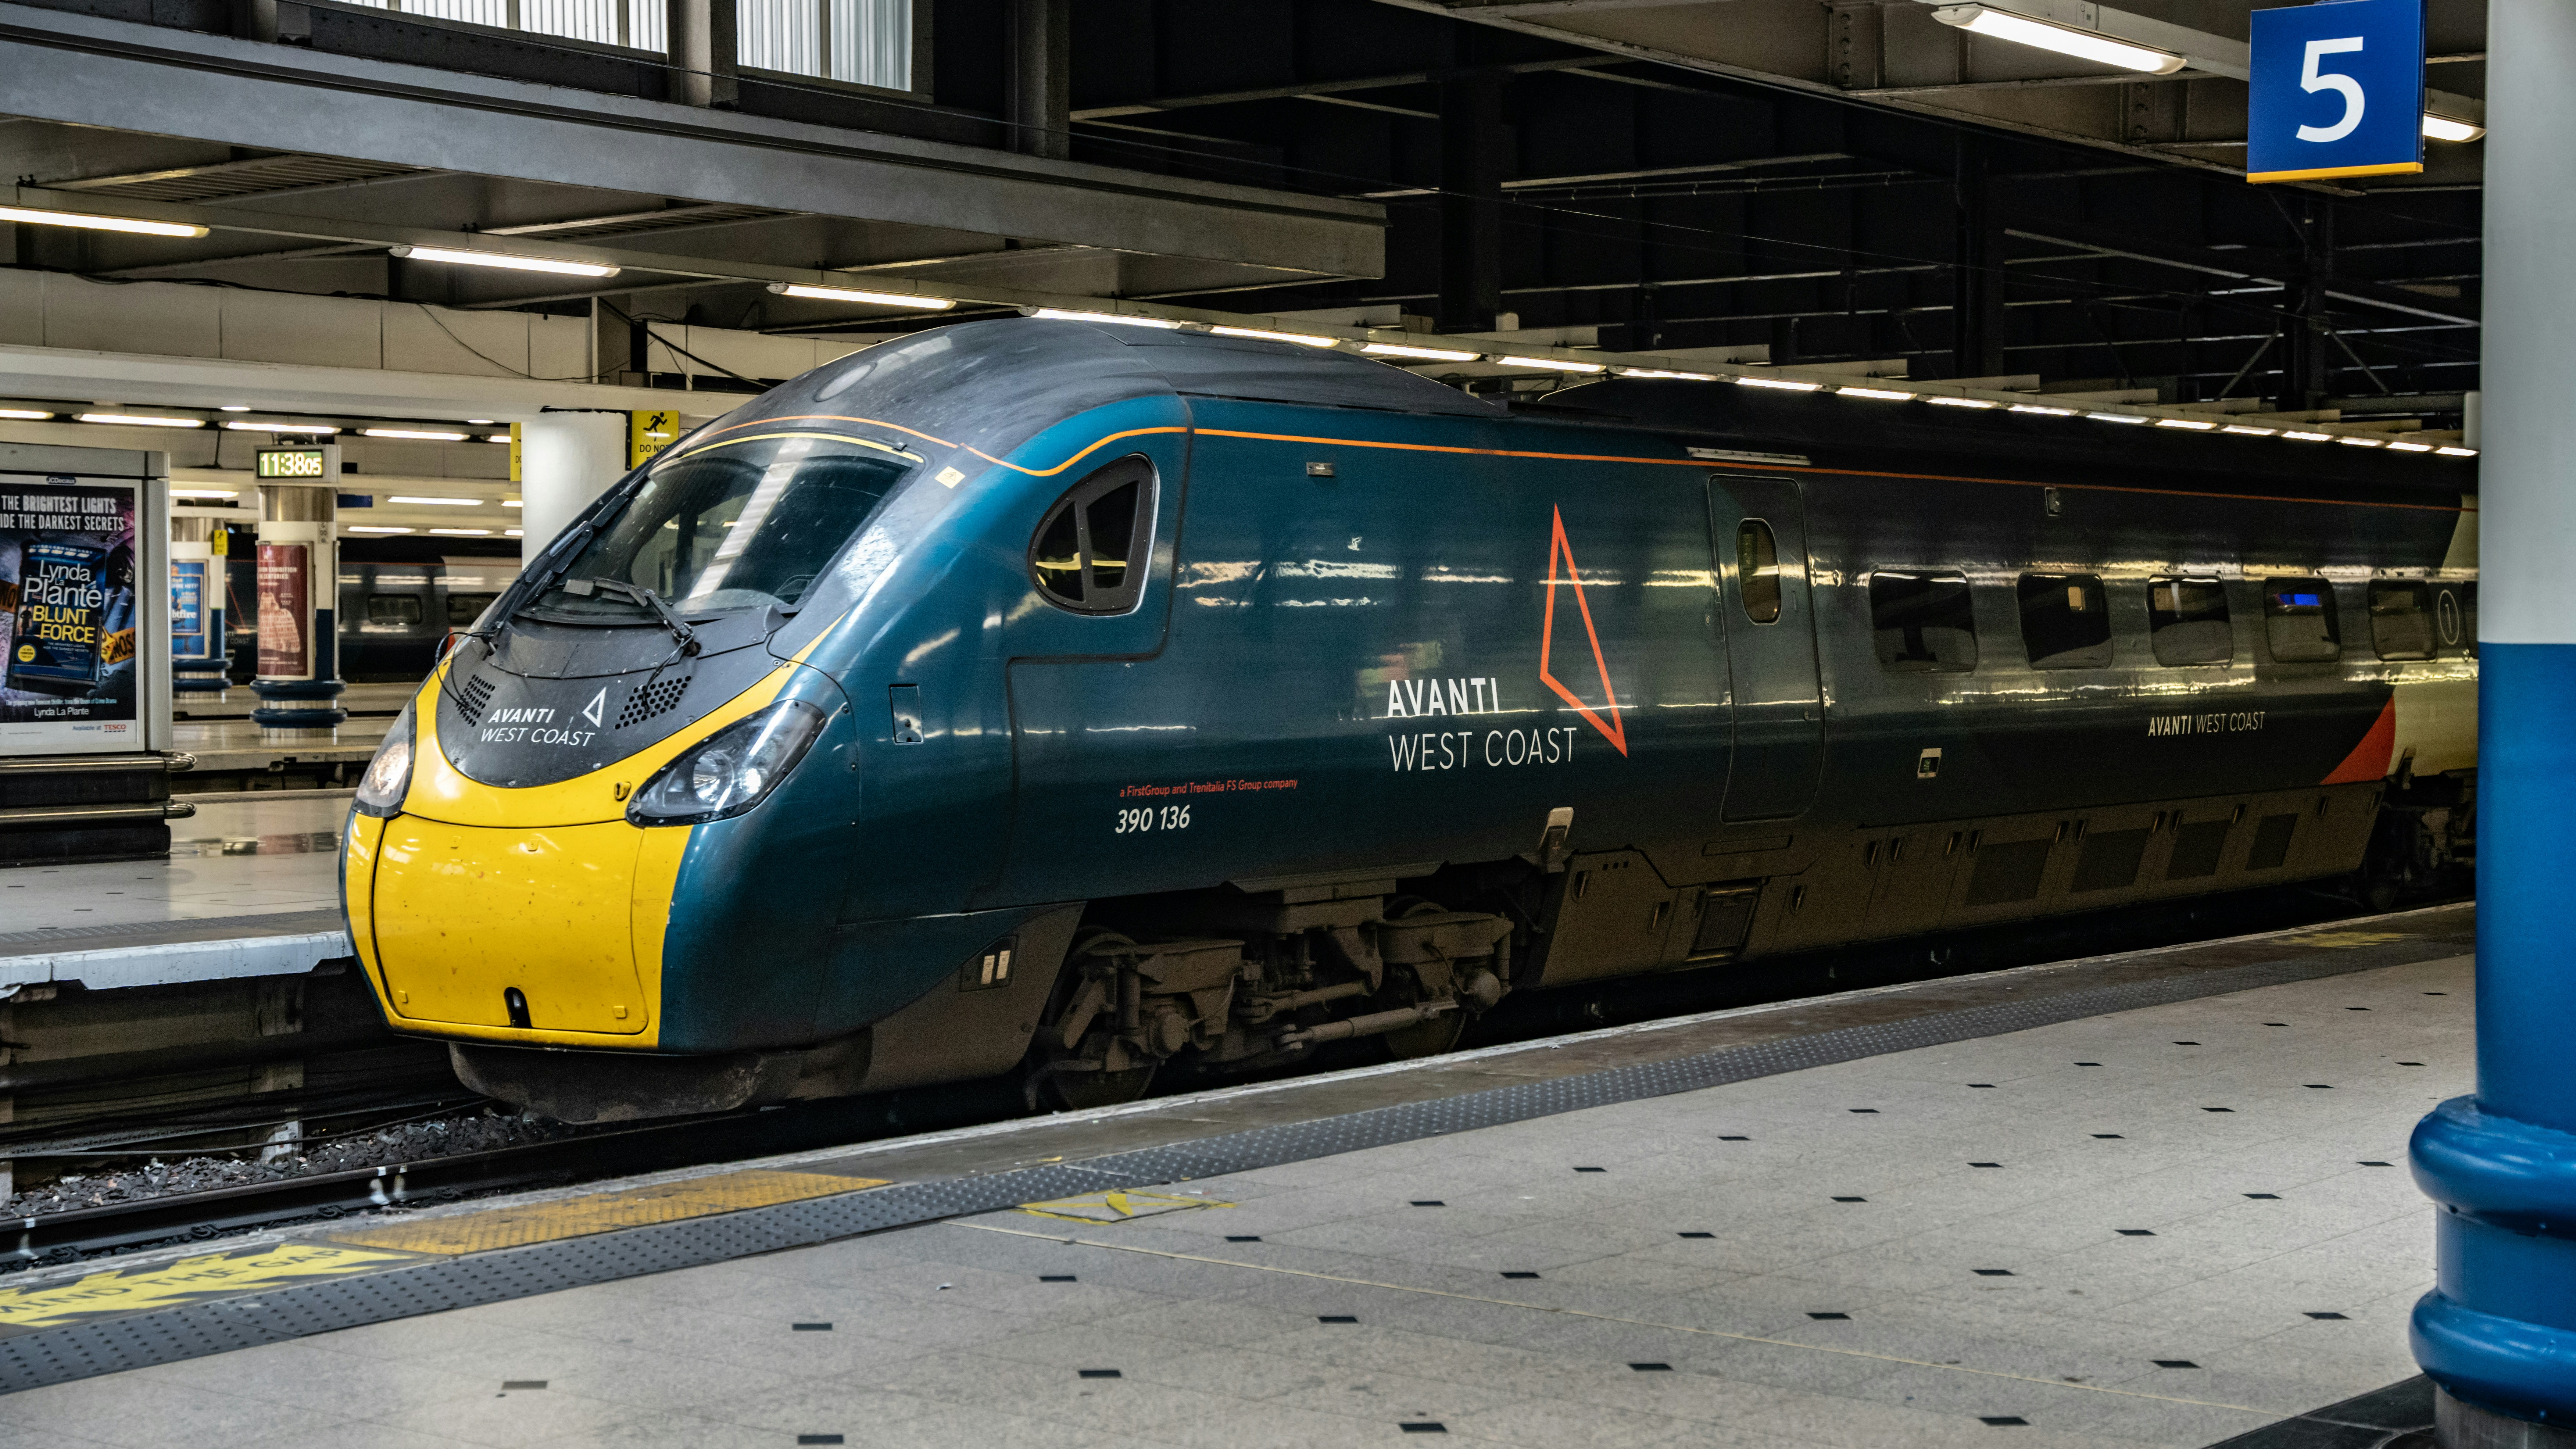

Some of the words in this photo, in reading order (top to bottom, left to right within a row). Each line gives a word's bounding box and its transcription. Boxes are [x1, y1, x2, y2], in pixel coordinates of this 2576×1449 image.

[2296, 36, 2365, 143] 5
[2, 495, 19, 510] THE
[23, 495, 78, 513] BRIGHTEST
[82, 497, 117, 514] LIGHTS
[18, 514, 36, 529] THE
[39, 515, 82, 530] DARKEST
[84, 516, 124, 531] SECRETS
[39, 559, 91, 583] Lynda
[55, 577, 64, 586] La
[23, 577, 102, 608] Plante
[33, 605, 90, 625] BLUNT
[40, 623, 95, 643] FORCE
[1388, 678, 1499, 718] AVANTI
[34, 708, 55, 718] Lynda
[56, 708, 65, 716] La
[67, 707, 89, 715] Plante
[488, 708, 555, 723] AVANTI
[2148, 715, 2192, 736] AVANTI
[2196, 713, 2226, 733] WEST
[2230, 711, 2265, 731] COAST
[481, 728, 528, 743] WEST
[531, 728, 595, 747] COAST
[1389, 732, 1472, 772] WEST
[1486, 727, 1577, 766] COAST
[1120, 789, 1124, 797] a
[1127, 785, 1170, 797] FirstGroup
[1172, 783, 1187, 795] and
[1189, 781, 1224, 794] Trenitalia
[1226, 780, 1236, 791] FS
[1238, 780, 1262, 791] Group
[1263, 779, 1298, 790] company
[1115, 808, 1153, 833] 390
[1160, 804, 1190, 831] 136
[130, 1268, 248, 1286] THE
[248, 1250, 342, 1267] GAP
